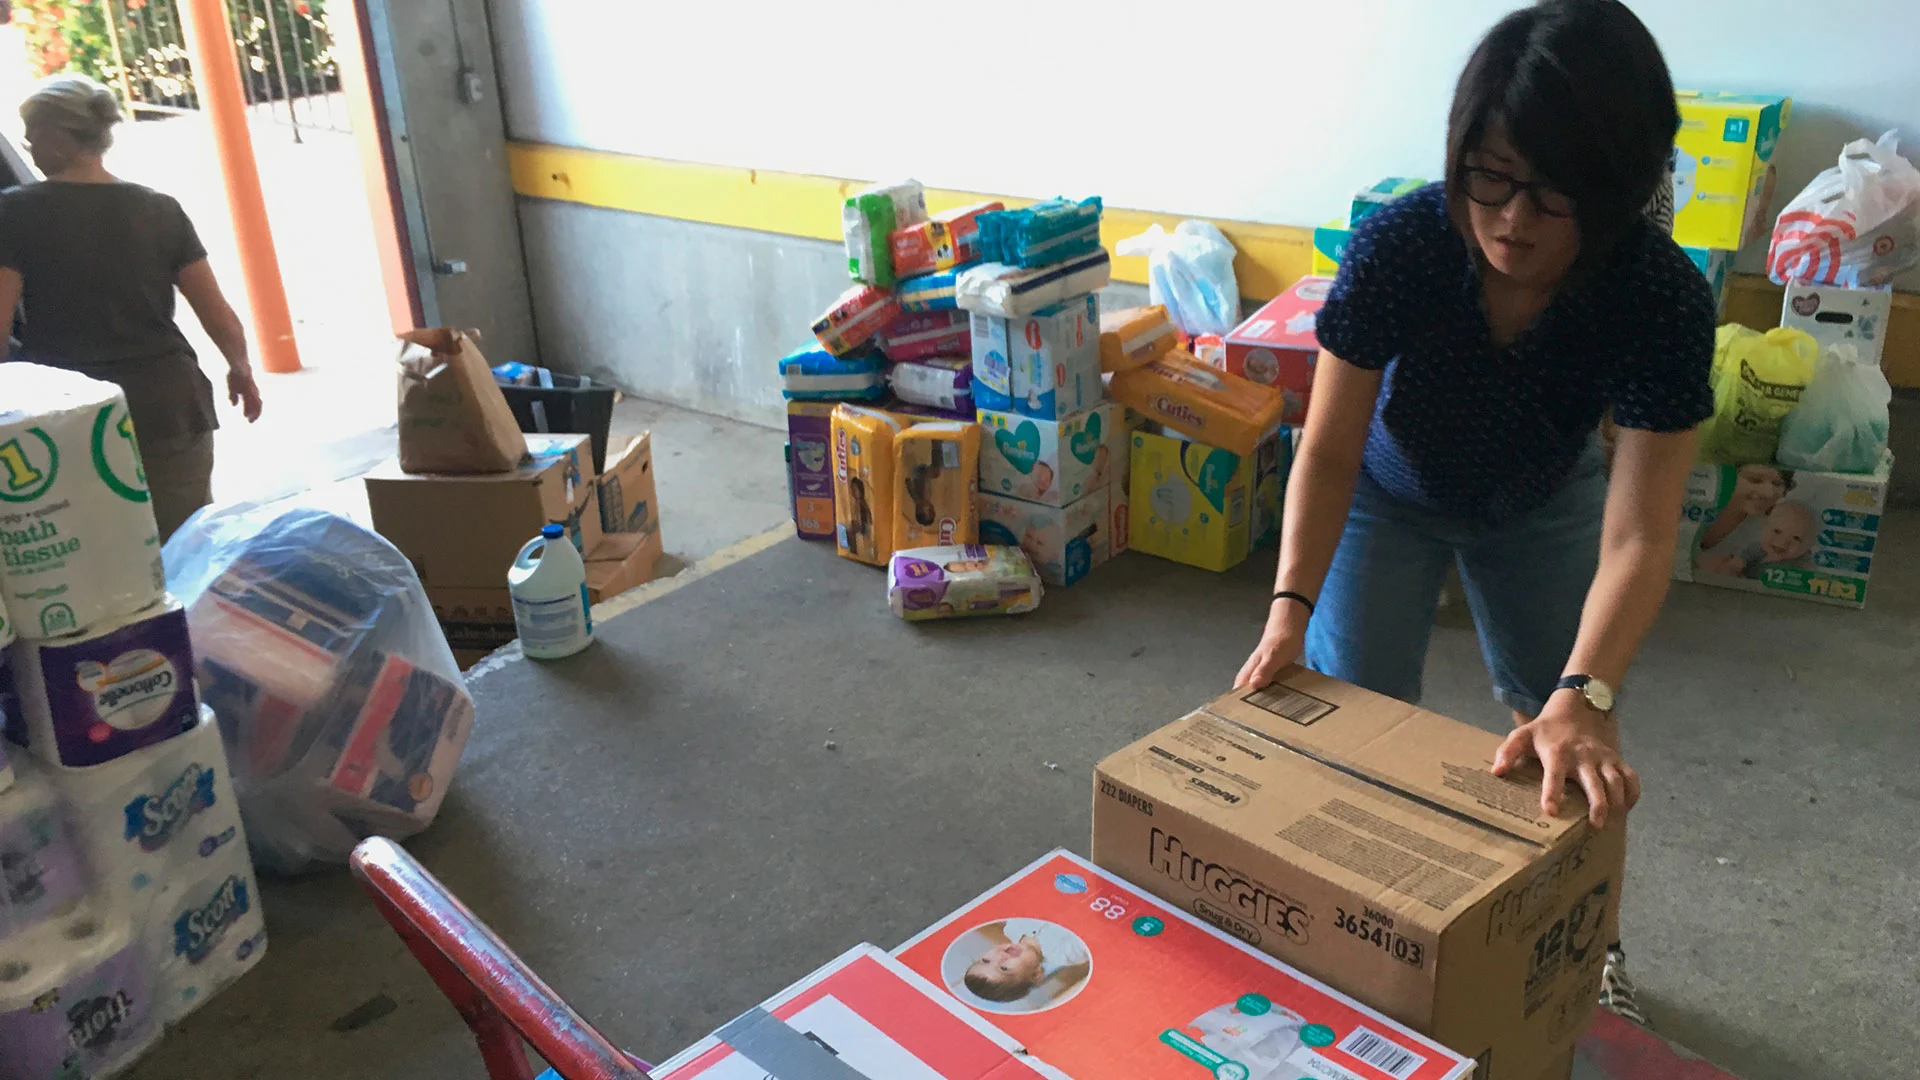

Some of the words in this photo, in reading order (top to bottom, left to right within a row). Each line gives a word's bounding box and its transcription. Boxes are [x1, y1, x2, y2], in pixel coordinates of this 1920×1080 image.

[2, 537, 81, 566] tissue
[1100, 779, 1117, 800] 222
[1118, 788, 1154, 817] DIAPERS
[1150, 826, 1311, 946] HUGGIES
[1089, 896, 1126, 920] 88
[1199, 902, 1225, 927] Snug
[1233, 919, 1256, 942] Dry
[1362, 905, 1394, 930] 36000
